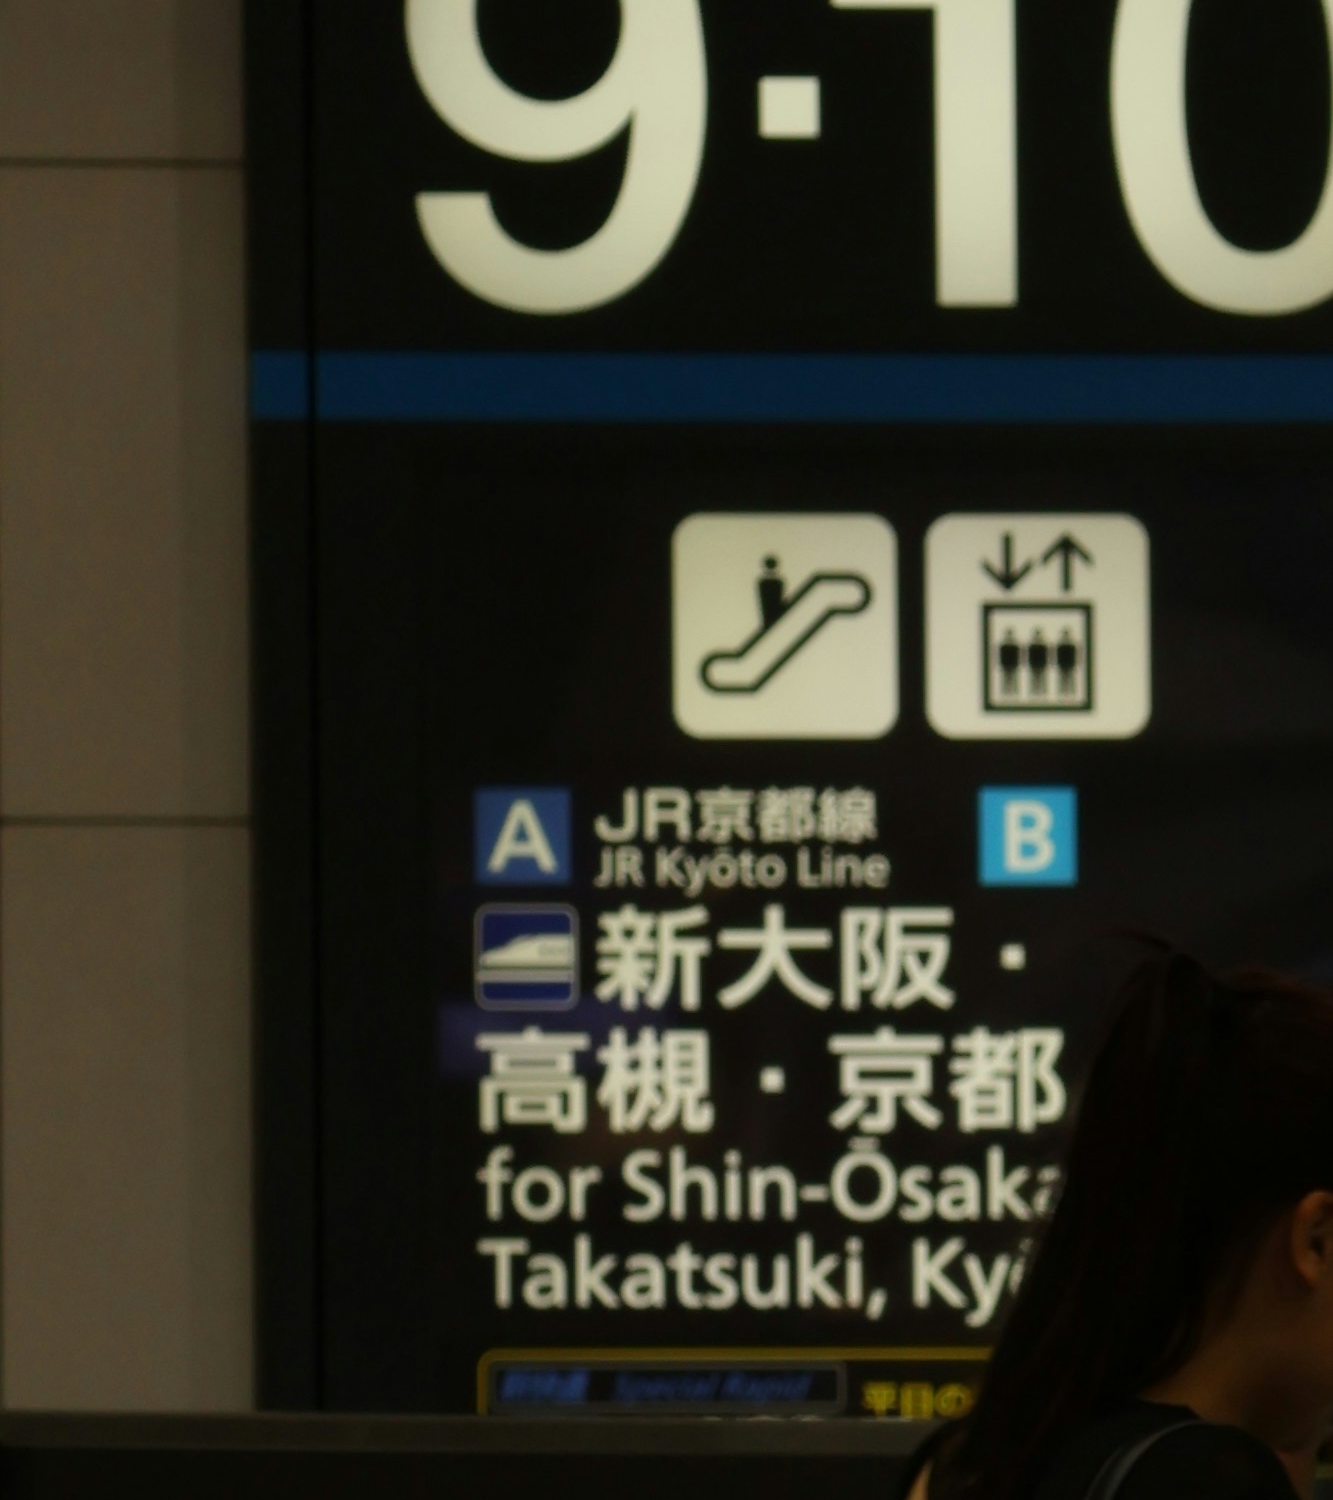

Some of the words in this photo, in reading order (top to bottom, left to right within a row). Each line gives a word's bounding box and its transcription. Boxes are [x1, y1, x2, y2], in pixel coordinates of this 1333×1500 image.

[485, 798, 559, 876] A
[593, 785, 879, 845] JR京都線
[1001, 798, 1057, 875] B
[593, 845, 646, 890] JR
[796, 845, 892, 890] Line
[473, 1024, 1068, 1135] 高槻・京都
[476, 1145, 603, 1223] for
[476, 1230, 889, 1322] Takatsuki,
